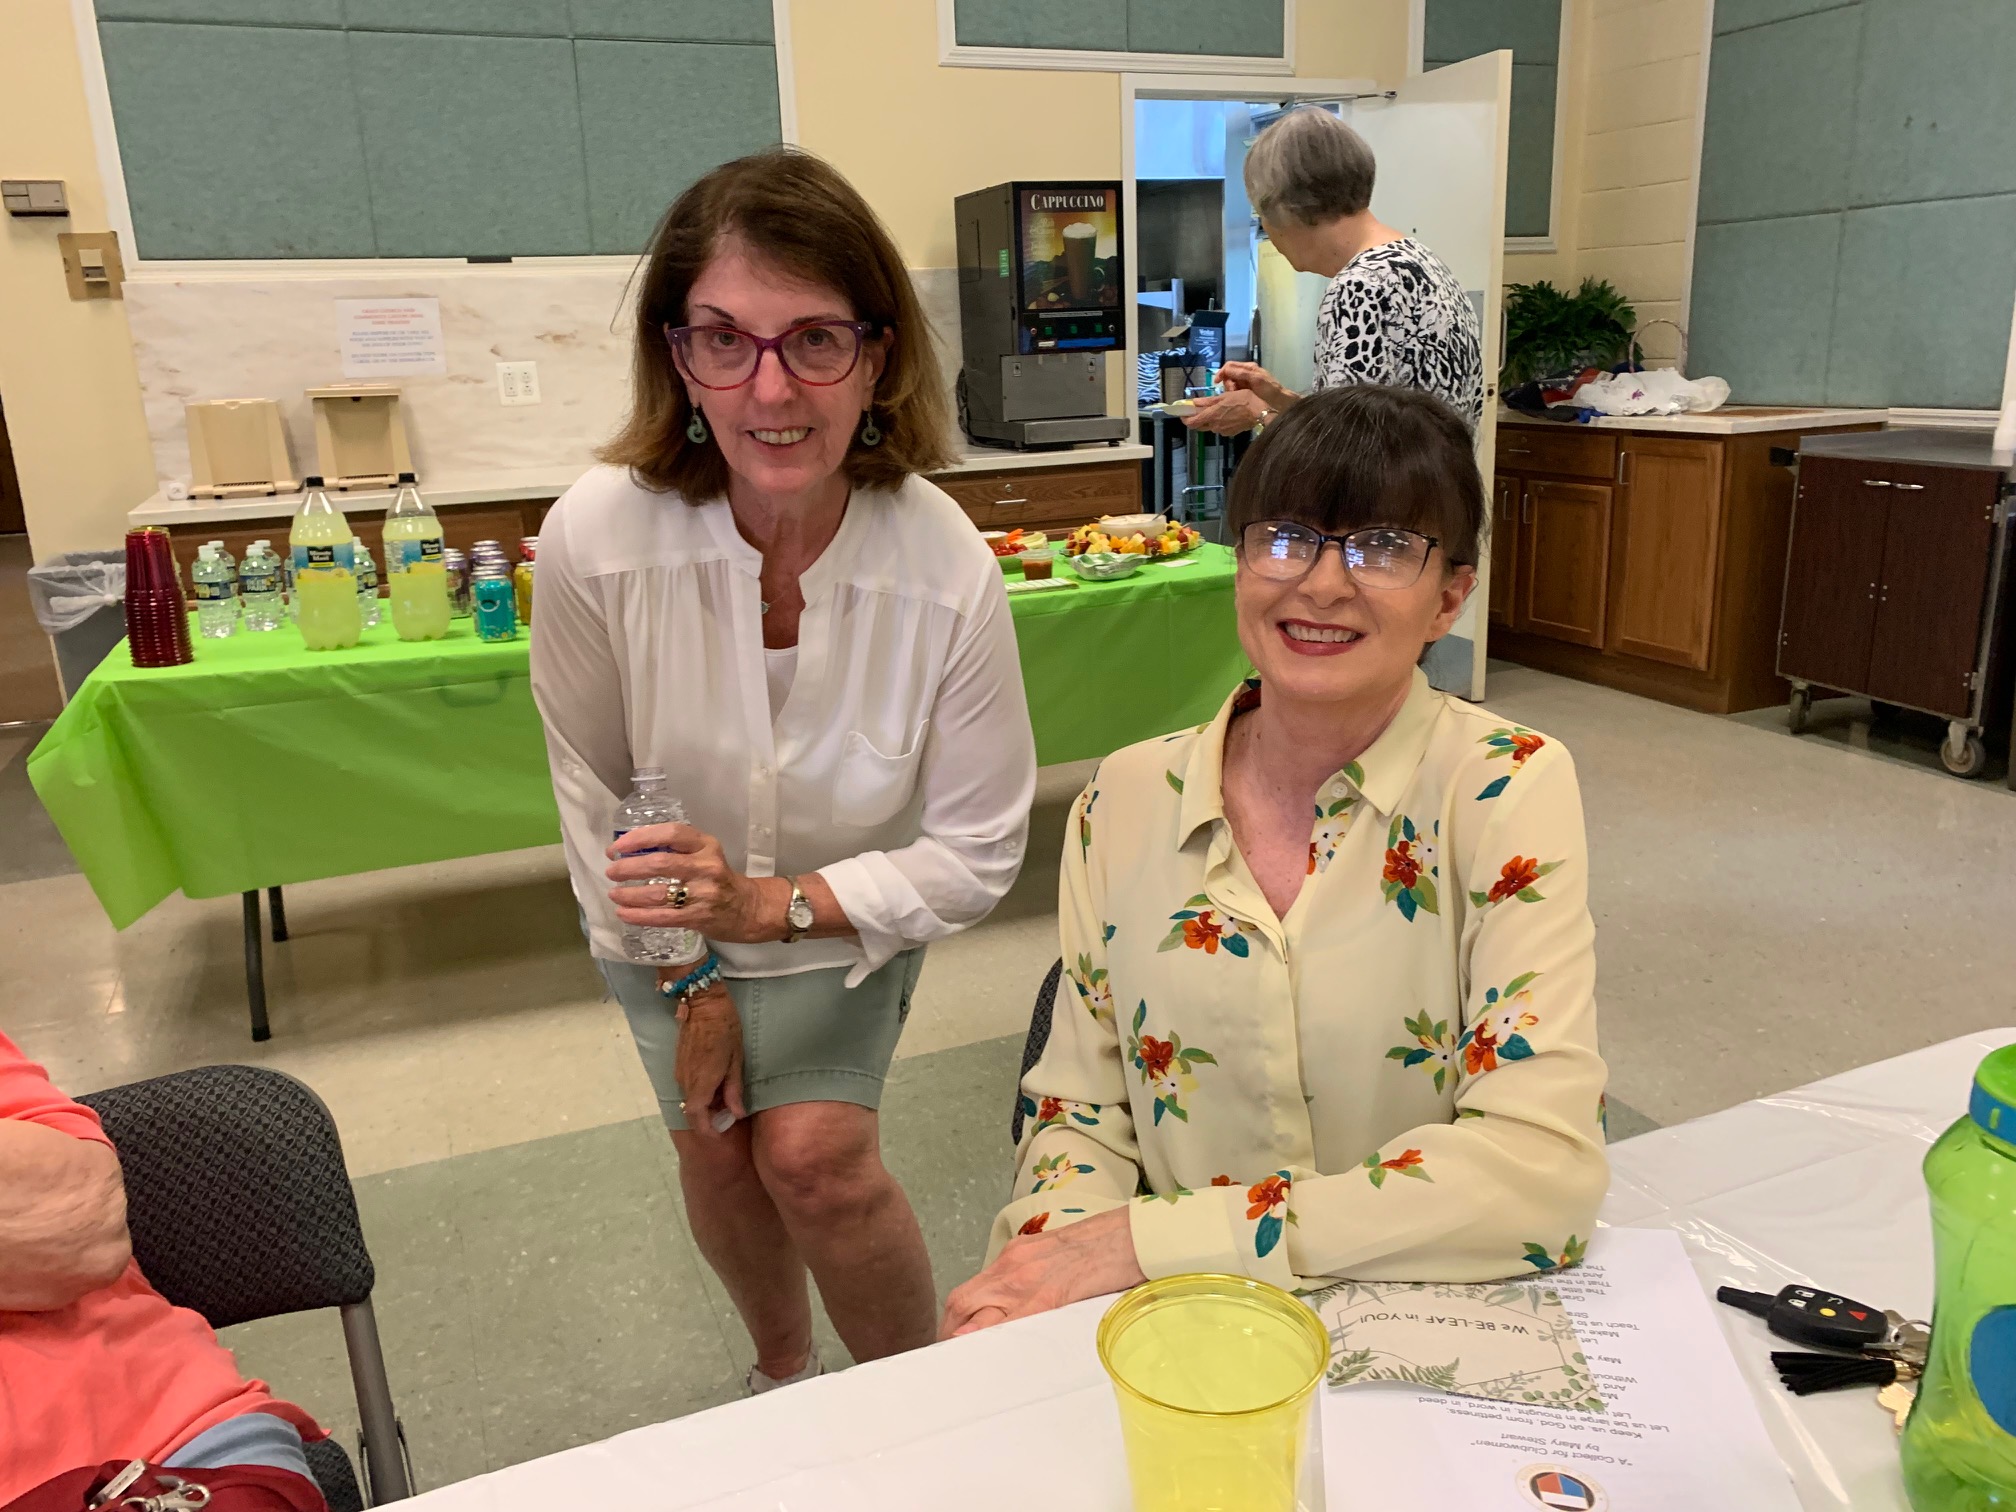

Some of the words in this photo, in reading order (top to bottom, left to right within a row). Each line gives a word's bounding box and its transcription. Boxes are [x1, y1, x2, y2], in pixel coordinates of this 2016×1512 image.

[1031, 194, 1104, 210] CAPPUCCINO
[1588, 1280, 1612, 1288] That
[1561, 1286, 1583, 1294] little
[1360, 1312, 1402, 1323] YOU!
[1405, 1314, 1418, 1322] in
[1426, 1316, 1496, 1330] BE-LEAF
[1606, 1322, 1640, 1330] Teach
[1500, 1324, 1529, 1335] We
[1589, 1330, 1620, 1338] Make
[1598, 1356, 1622, 1364] May
[1593, 1374, 1638, 1384] Without
[1603, 1384, 1626, 1392] And
[1506, 1416, 1534, 1425] from
[1580, 1416, 1610, 1426] large
[1614, 1420, 1629, 1428] be
[1649, 1424, 1670, 1432] Let
[1610, 1429, 1642, 1439] Keep
[1500, 1433, 1546, 1445] Stewart
[1470, 1440, 1548, 1455] Clubwomen"
[1551, 1439, 1581, 1450] Mary
[1586, 1444, 1600, 1452] by
[1553, 1450, 1568, 1458] for
[1572, 1452, 1614, 1464] Collect
